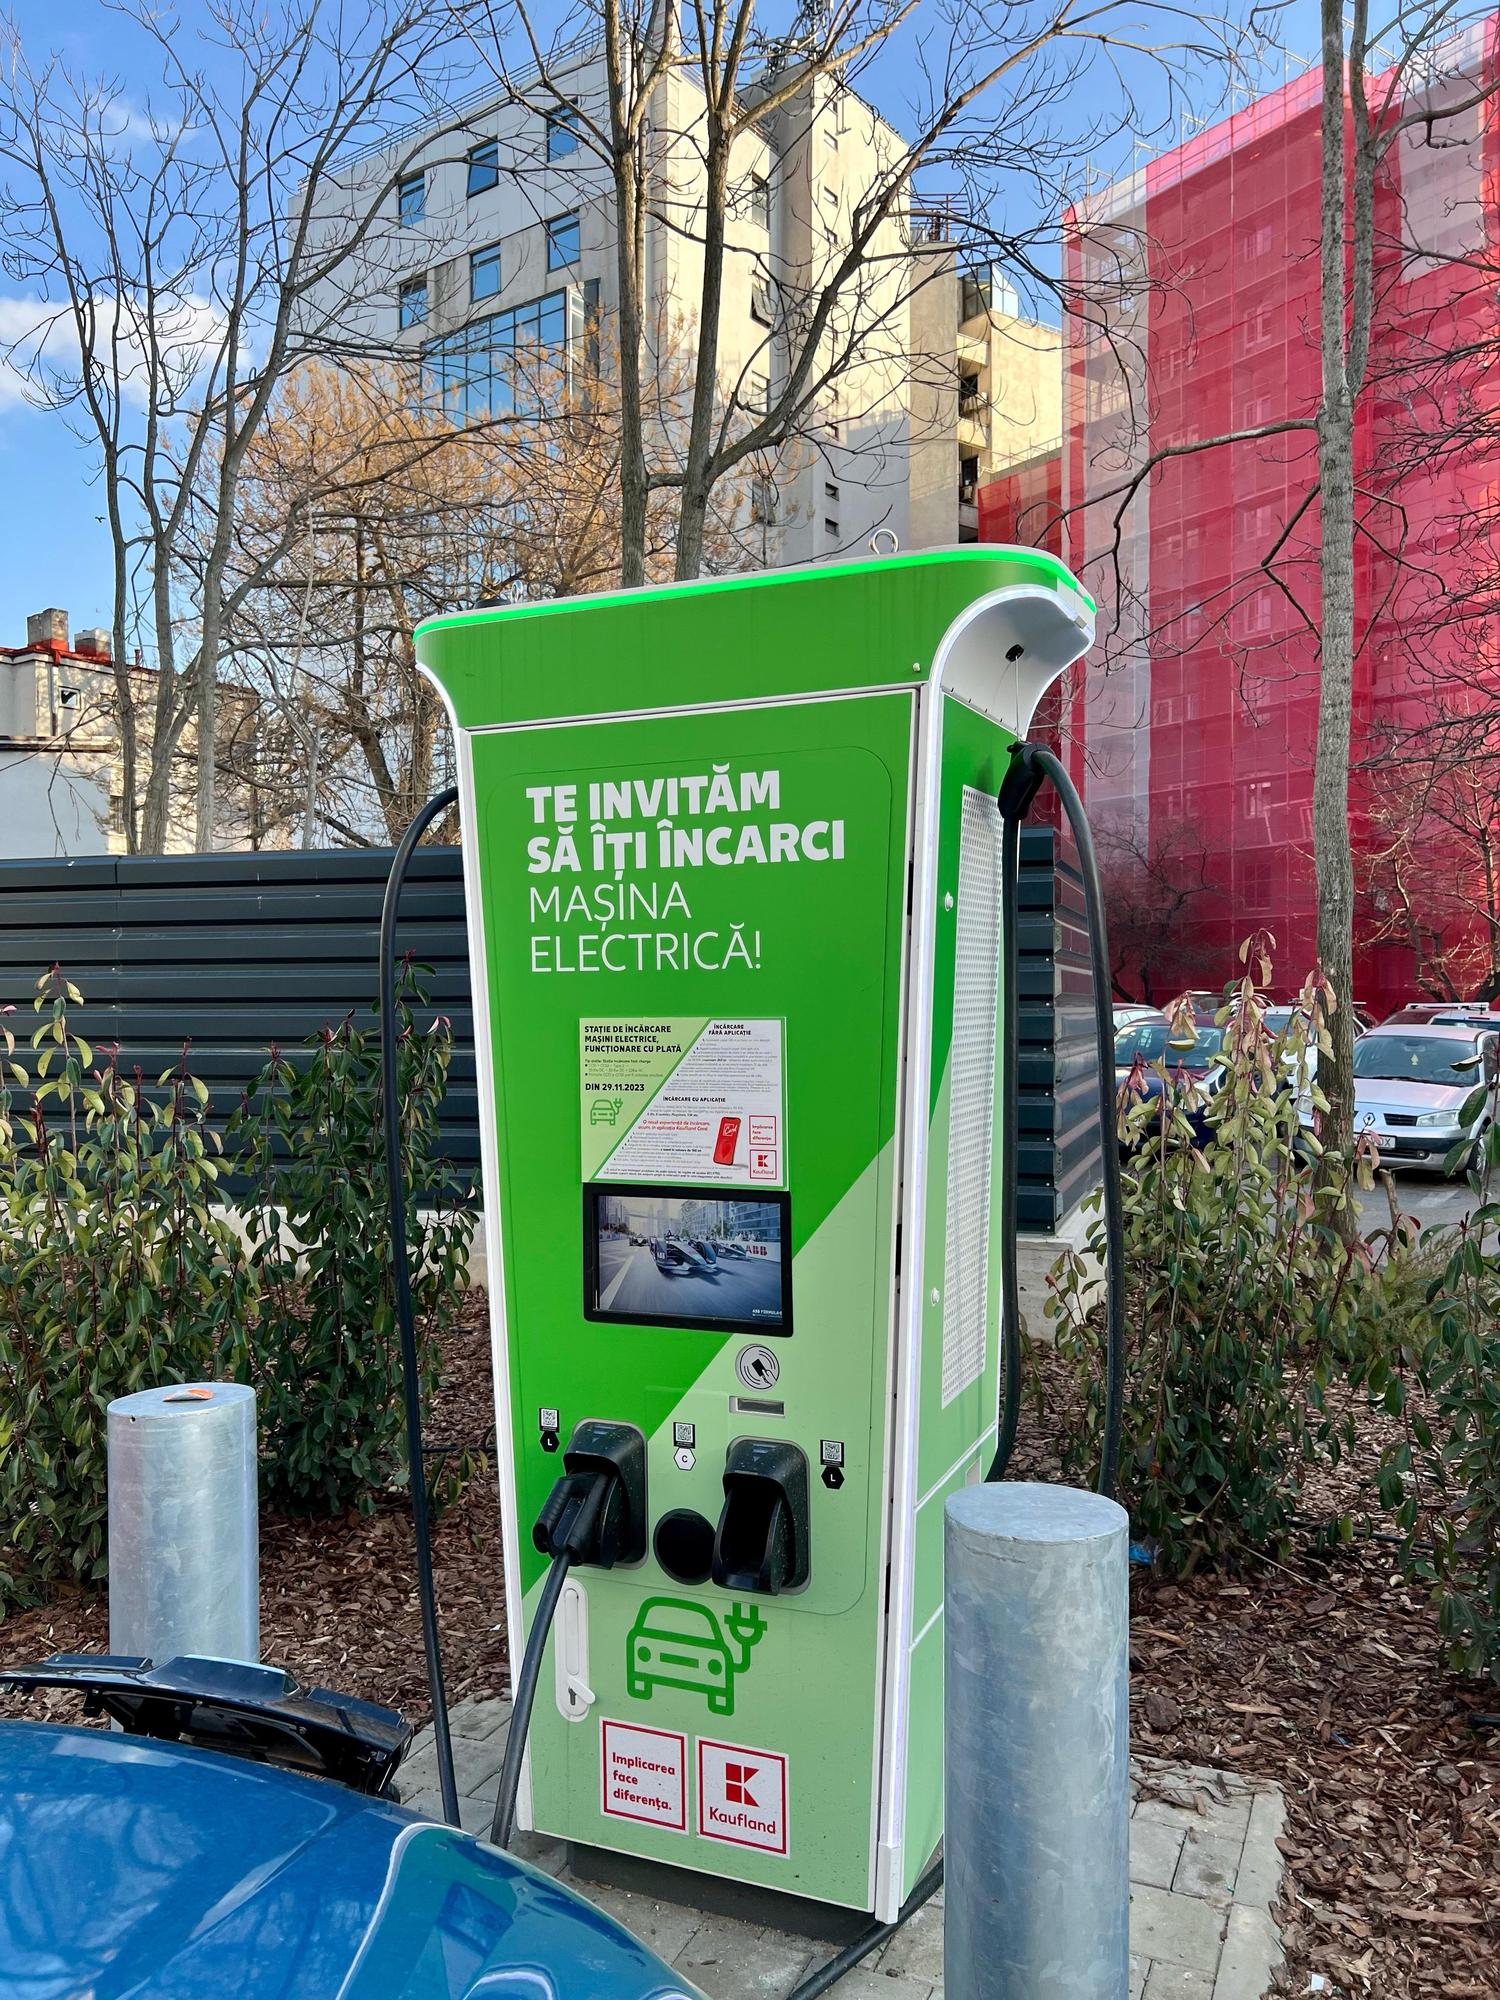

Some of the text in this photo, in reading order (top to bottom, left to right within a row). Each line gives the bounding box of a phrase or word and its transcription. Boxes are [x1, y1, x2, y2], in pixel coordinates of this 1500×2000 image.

[526, 762, 781, 823] TE INVITĂM
[527, 818, 845, 880] SĂ ÎȚI ÎNCARCI
[530, 881, 692, 931] MAȘINA
[530, 922, 762, 973] ELECTRICĂ!
[584, 1024, 672, 1034] STAȚIE DE ÎNCĂRCARE
[584, 1035, 659, 1044] MAȘINI ELECTRICE,
[584, 1045, 641, 1054] FUNCȚIONARE
[656, 1044, 682, 1052] PLATĂ
[585, 1083, 645, 1091] DIN 29.11.2023
[745, 1245, 768, 1256] ABB
[547, 1438, 553, 1446] L
[681, 1454, 688, 1463] C
[830, 1473, 836, 1482] L
[612, 1752, 675, 1775] Implicarea
[613, 1770, 638, 1785] face
[613, 1788, 672, 1811] diferența.
[709, 1806, 776, 1835] Kaufland
